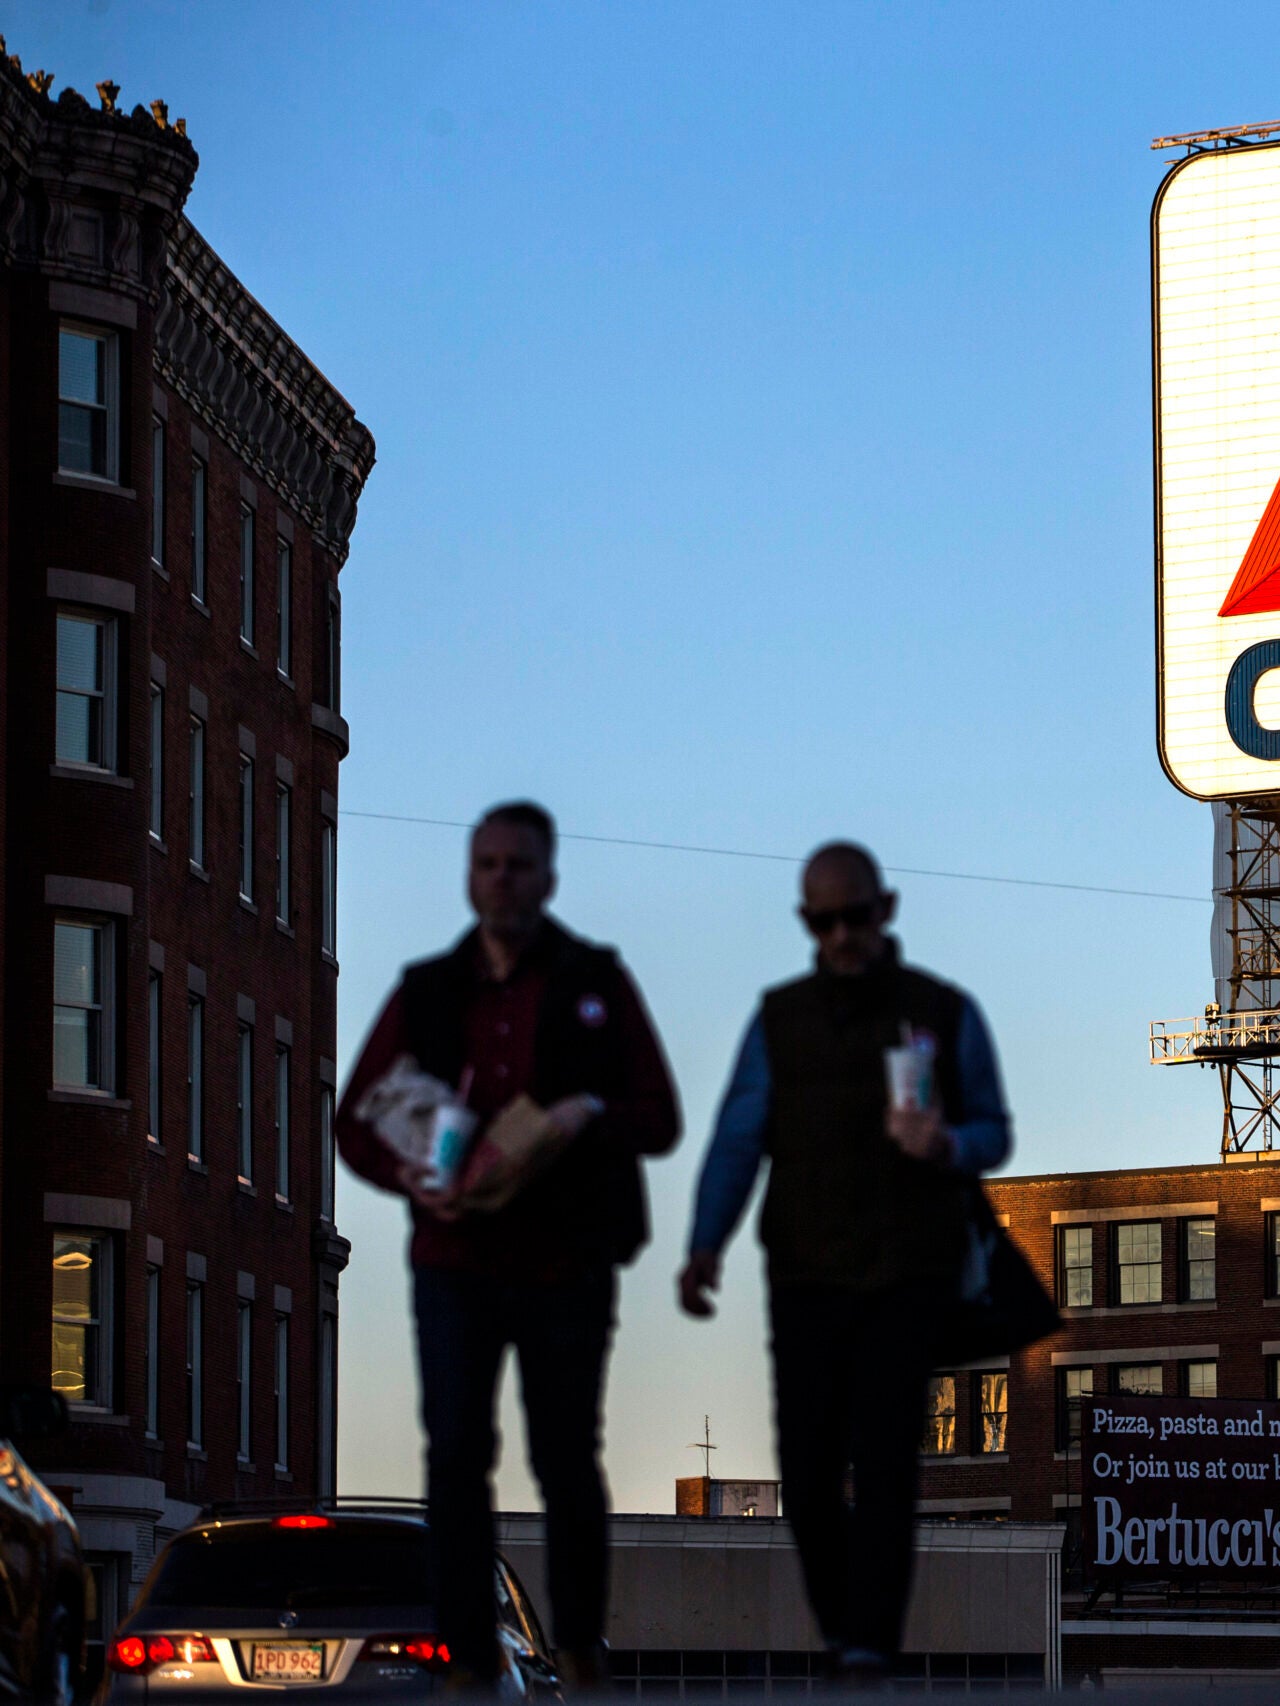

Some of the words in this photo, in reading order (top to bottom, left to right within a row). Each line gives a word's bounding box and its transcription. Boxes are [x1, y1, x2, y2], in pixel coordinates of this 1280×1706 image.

[1092, 1408, 1155, 1440] Pizza,
[1159, 1412, 1219, 1441] pasta
[1223, 1409, 1264, 1437] and
[1092, 1452, 1123, 1478] Or
[1125, 1452, 1171, 1485] join
[1173, 1459, 1201, 1479] us
[1205, 1457, 1227, 1479] at
[1231, 1461, 1269, 1481] our
[290, 1652, 321, 1670] 962
